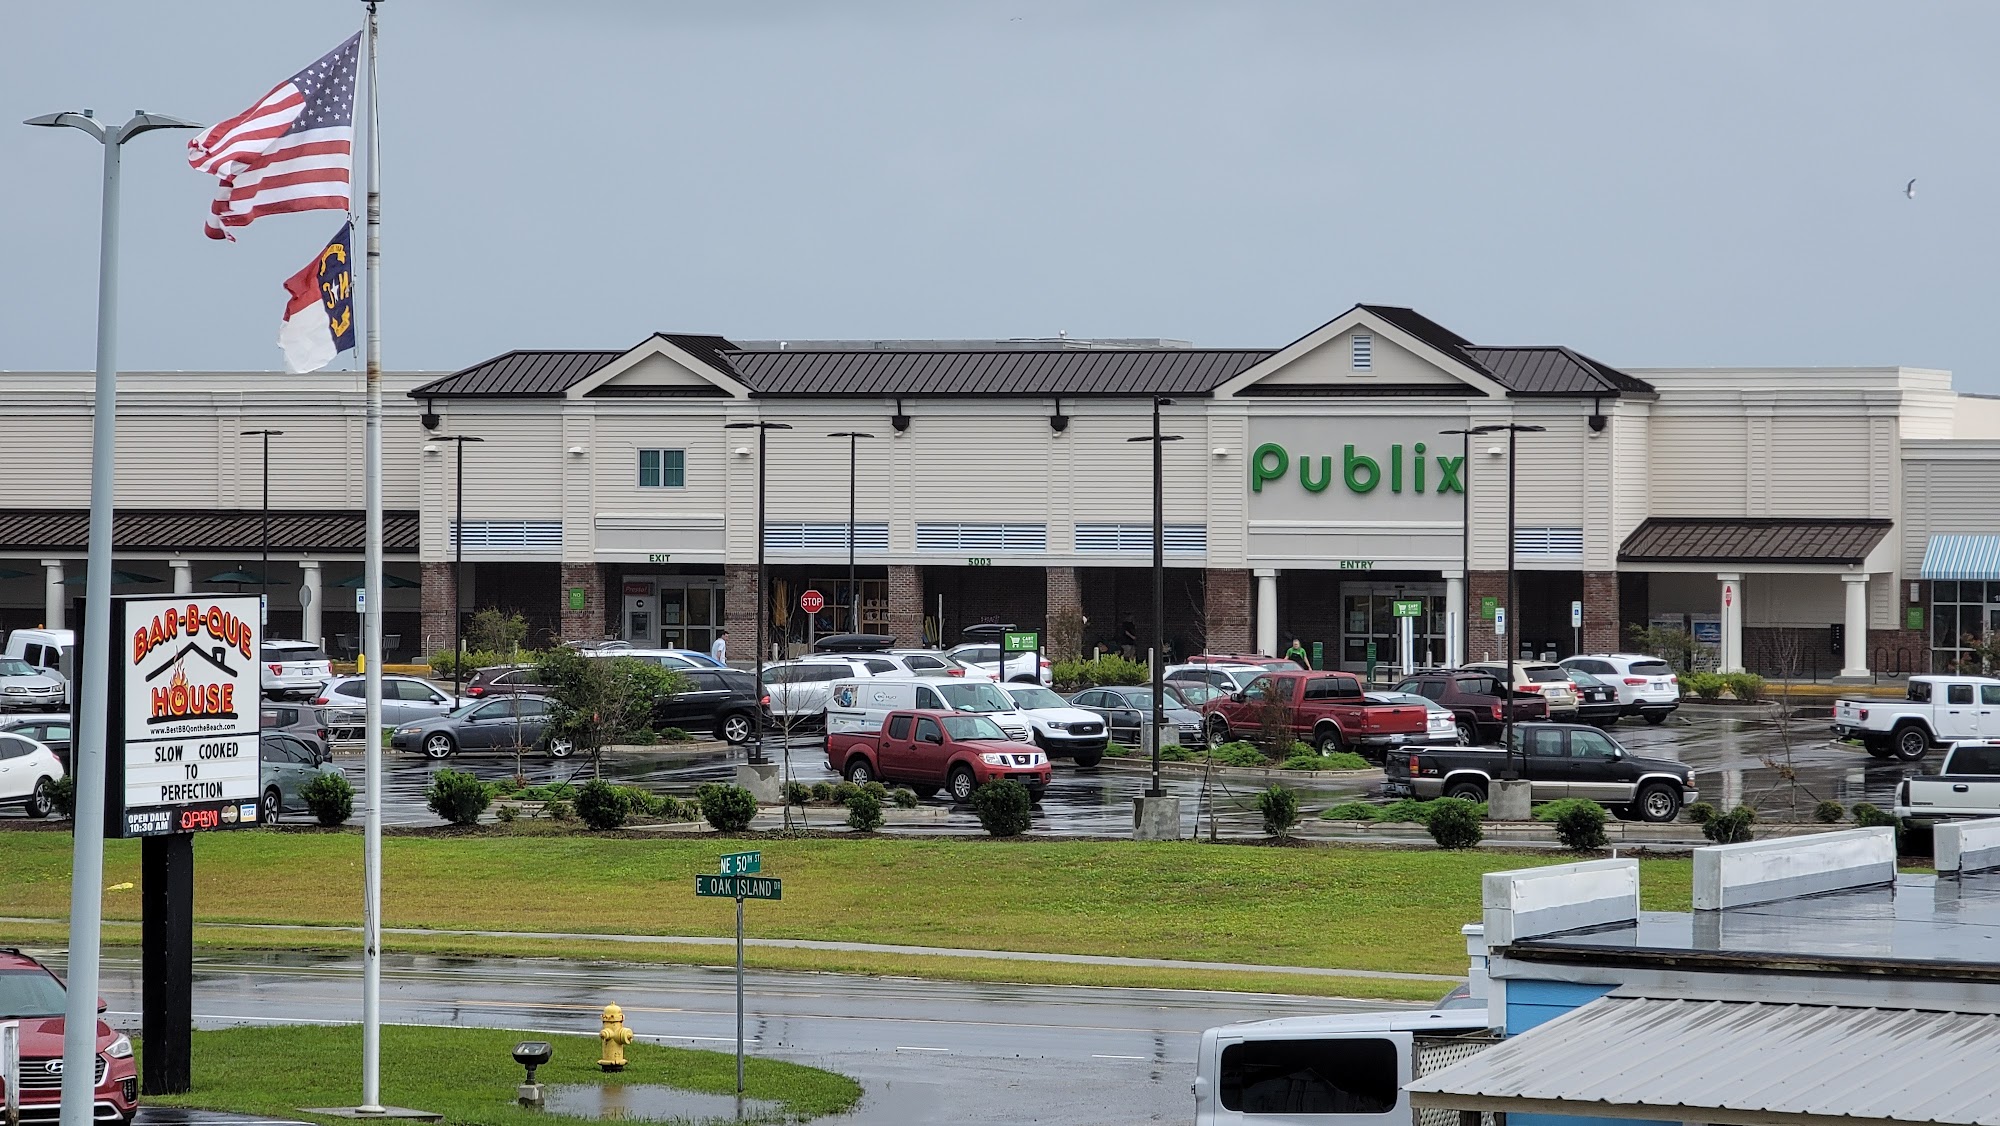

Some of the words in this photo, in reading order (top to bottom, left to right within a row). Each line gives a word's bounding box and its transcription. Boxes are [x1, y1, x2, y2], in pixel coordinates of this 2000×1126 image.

[1252, 442, 1464, 493] Publix
[649, 554, 670, 562] EXIT
[968, 558, 992, 566] 5003
[1340, 561, 1374, 569] ENTRY
[802, 597, 822, 607] STOP
[133, 604, 252, 666] BAR-B-QUE
[151, 683, 235, 717] HOUSE
[150, 723, 236, 735] www.BestBBQontheBeach.com
[155, 745, 183, 762] SLOW
[199, 742, 239, 760] COOKED
[185, 764, 198, 780] TO
[161, 781, 223, 801] PERFECTION
[128, 813, 149, 824] OPEN
[149, 811, 171, 822] DAILY
[181, 810, 218, 829] OPEN
[242, 809, 254, 817] VISA
[130, 822, 153, 833] 10:30
[155, 821, 168, 831] AM
[720, 857, 731, 874] NE
[754, 853, 760, 863] ST
[696, 877, 706, 894] E.
[710, 878, 732, 895] OAK
[737, 879, 772, 897] ISLAND
